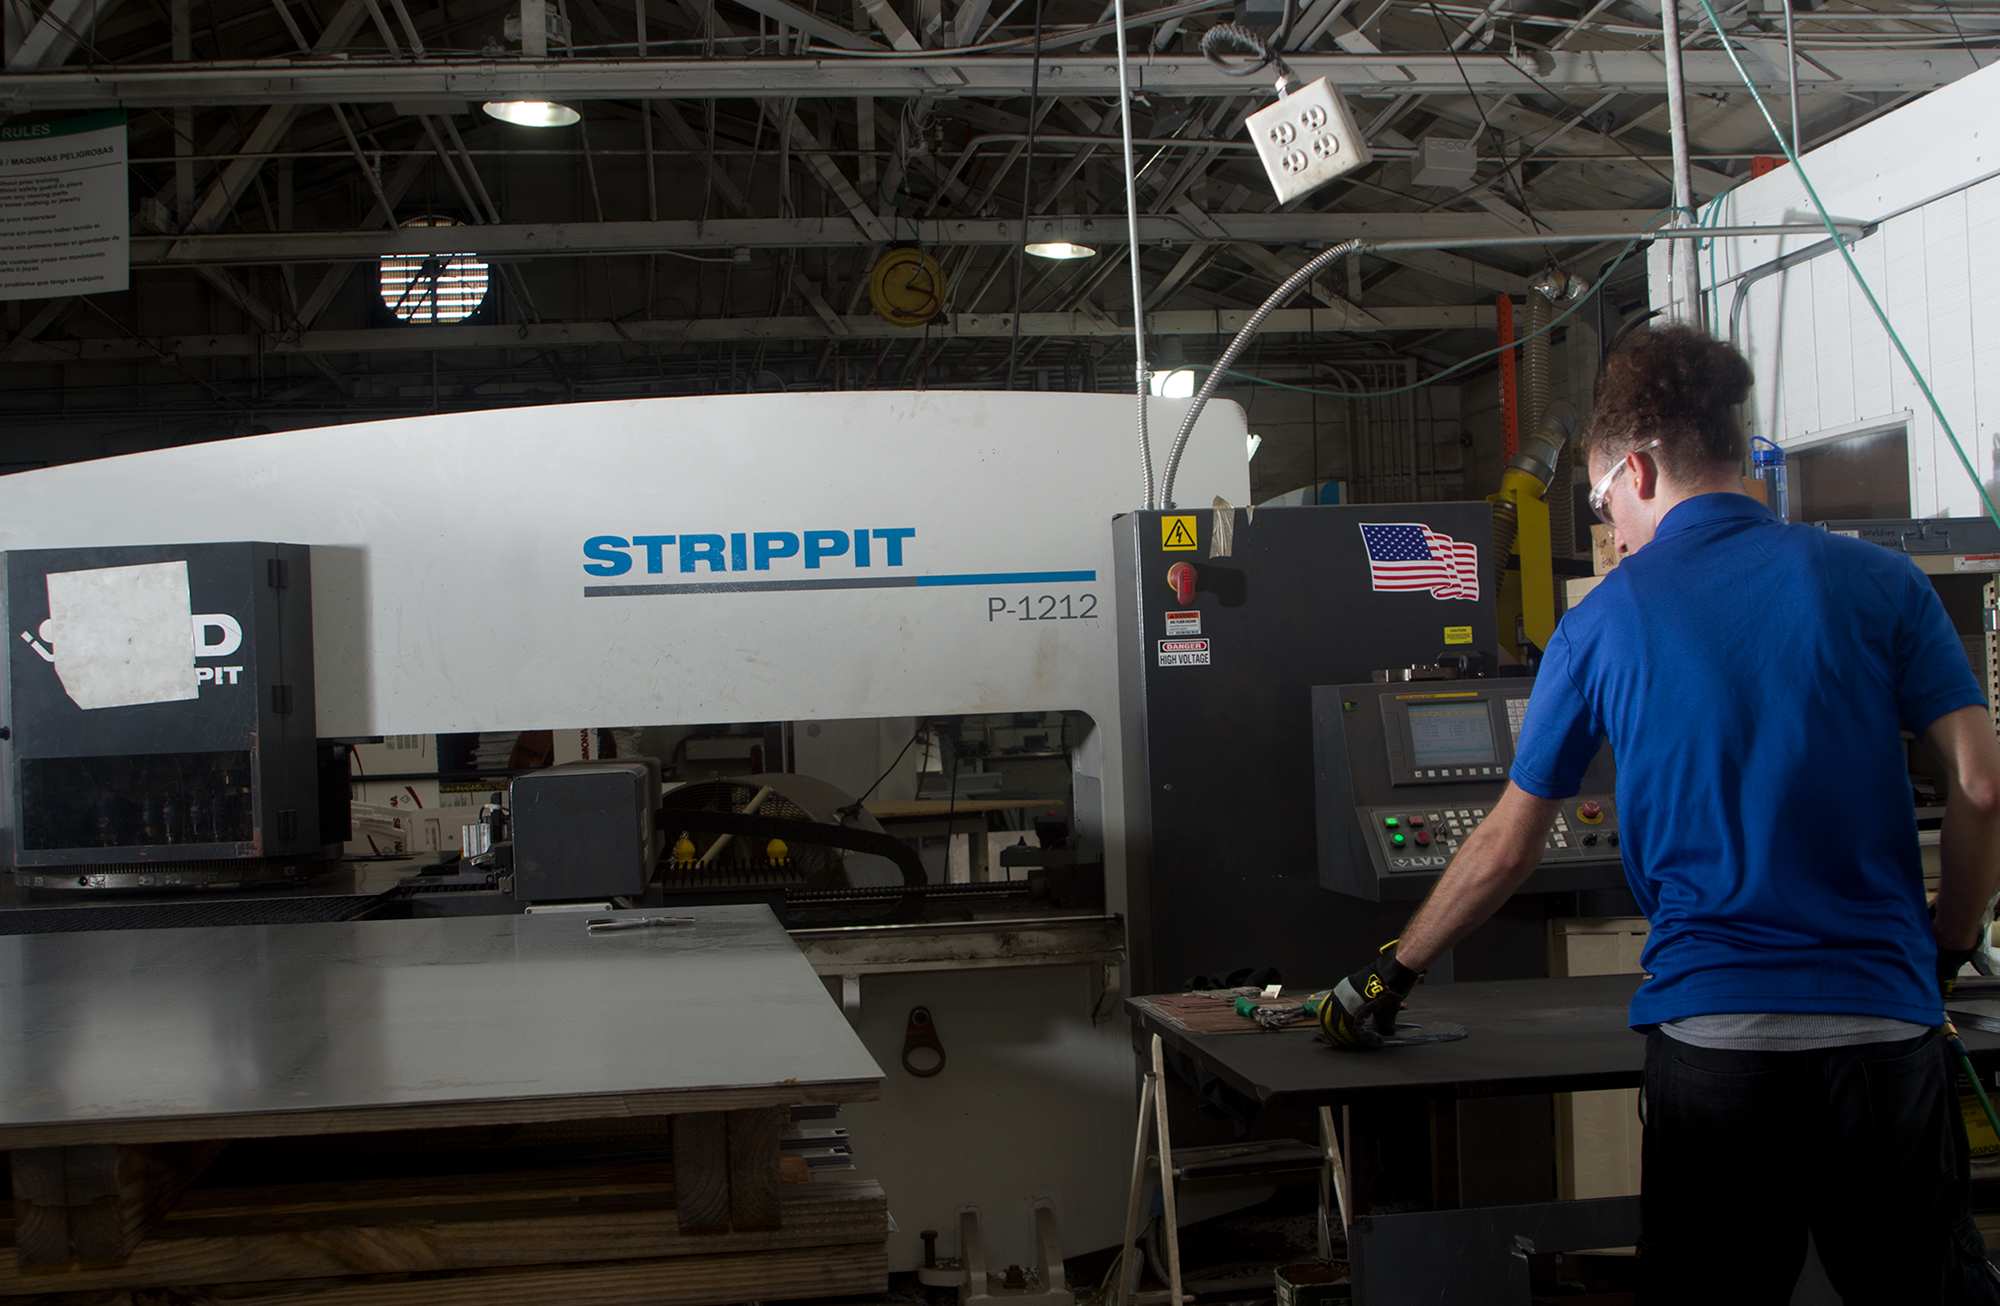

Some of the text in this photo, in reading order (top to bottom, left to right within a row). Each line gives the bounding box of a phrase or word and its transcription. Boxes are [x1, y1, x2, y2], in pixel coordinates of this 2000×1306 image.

[1, 123, 50, 139] RULES
[10, 154, 58, 166] MAQUINAS
[59, 145, 114, 161] PELIGROSAS
[22, 214, 57, 222] supervisor
[27, 228, 53, 237] primero
[53, 225, 72, 233] haber
[73, 223, 93, 231] tenido
[27, 242, 52, 251] primero
[78, 236, 110, 246] guardador
[9, 257, 39, 265] cualquier
[40, 256, 58, 264] pieza
[68, 251, 105, 260] movimiento
[4, 280, 35, 289] problema
[1863, 529, 1895, 537] Welding
[583, 527, 915, 578] STRIPPIT
[988, 593, 1099, 622] P-1212
[1160, 653, 1209, 665] HIGH VOLTAGE
[1410, 856, 1446, 867] LVD
